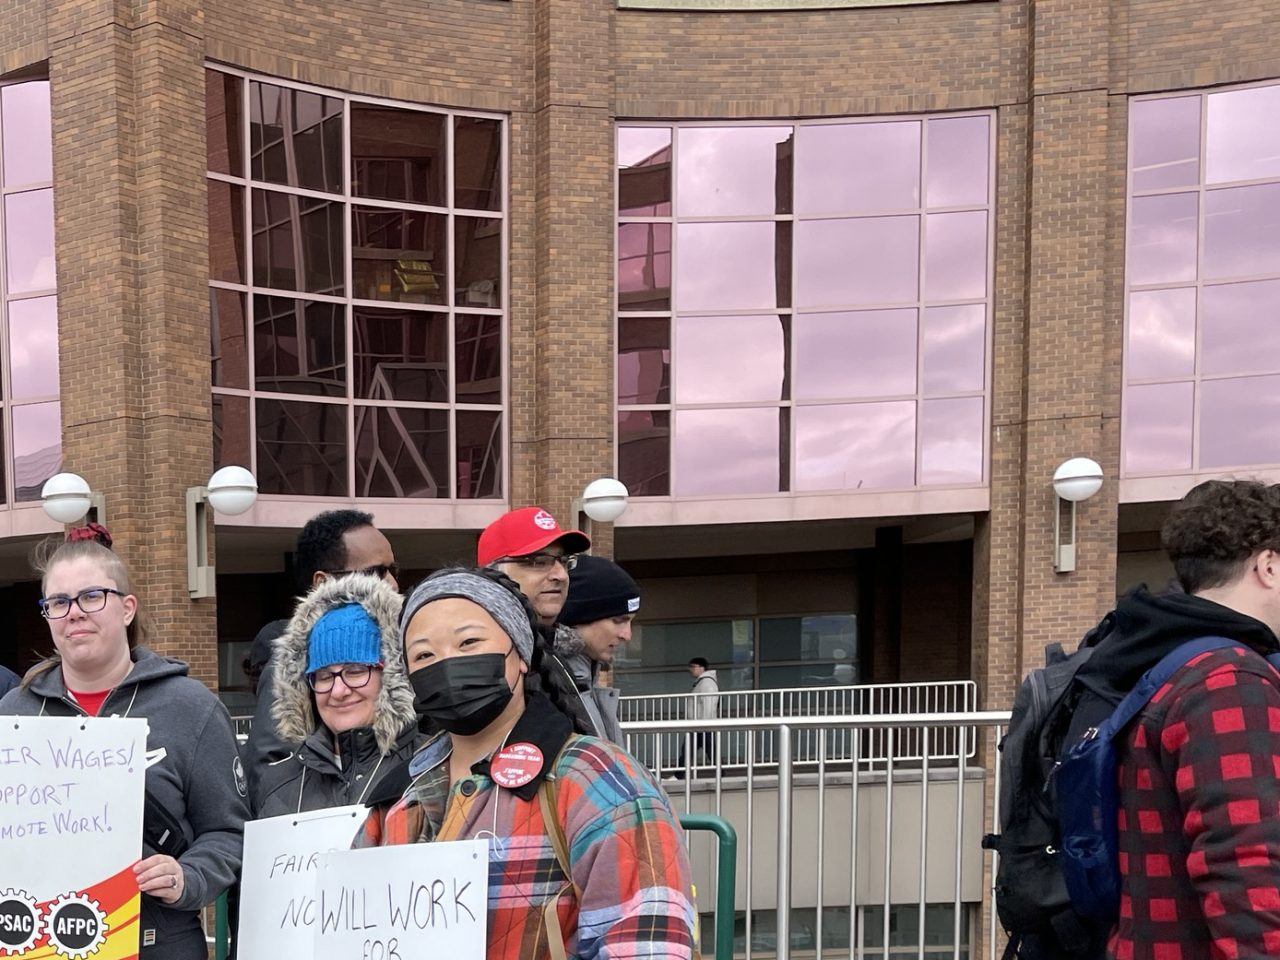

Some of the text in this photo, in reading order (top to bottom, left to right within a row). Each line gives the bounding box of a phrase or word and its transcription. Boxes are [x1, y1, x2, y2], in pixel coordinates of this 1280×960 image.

[47, 736, 136, 773] WAGES!
[269, 851, 319, 879] FAIR
[320, 877, 477, 935] WILL WORK
[57, 917, 96, 936] AFPC
